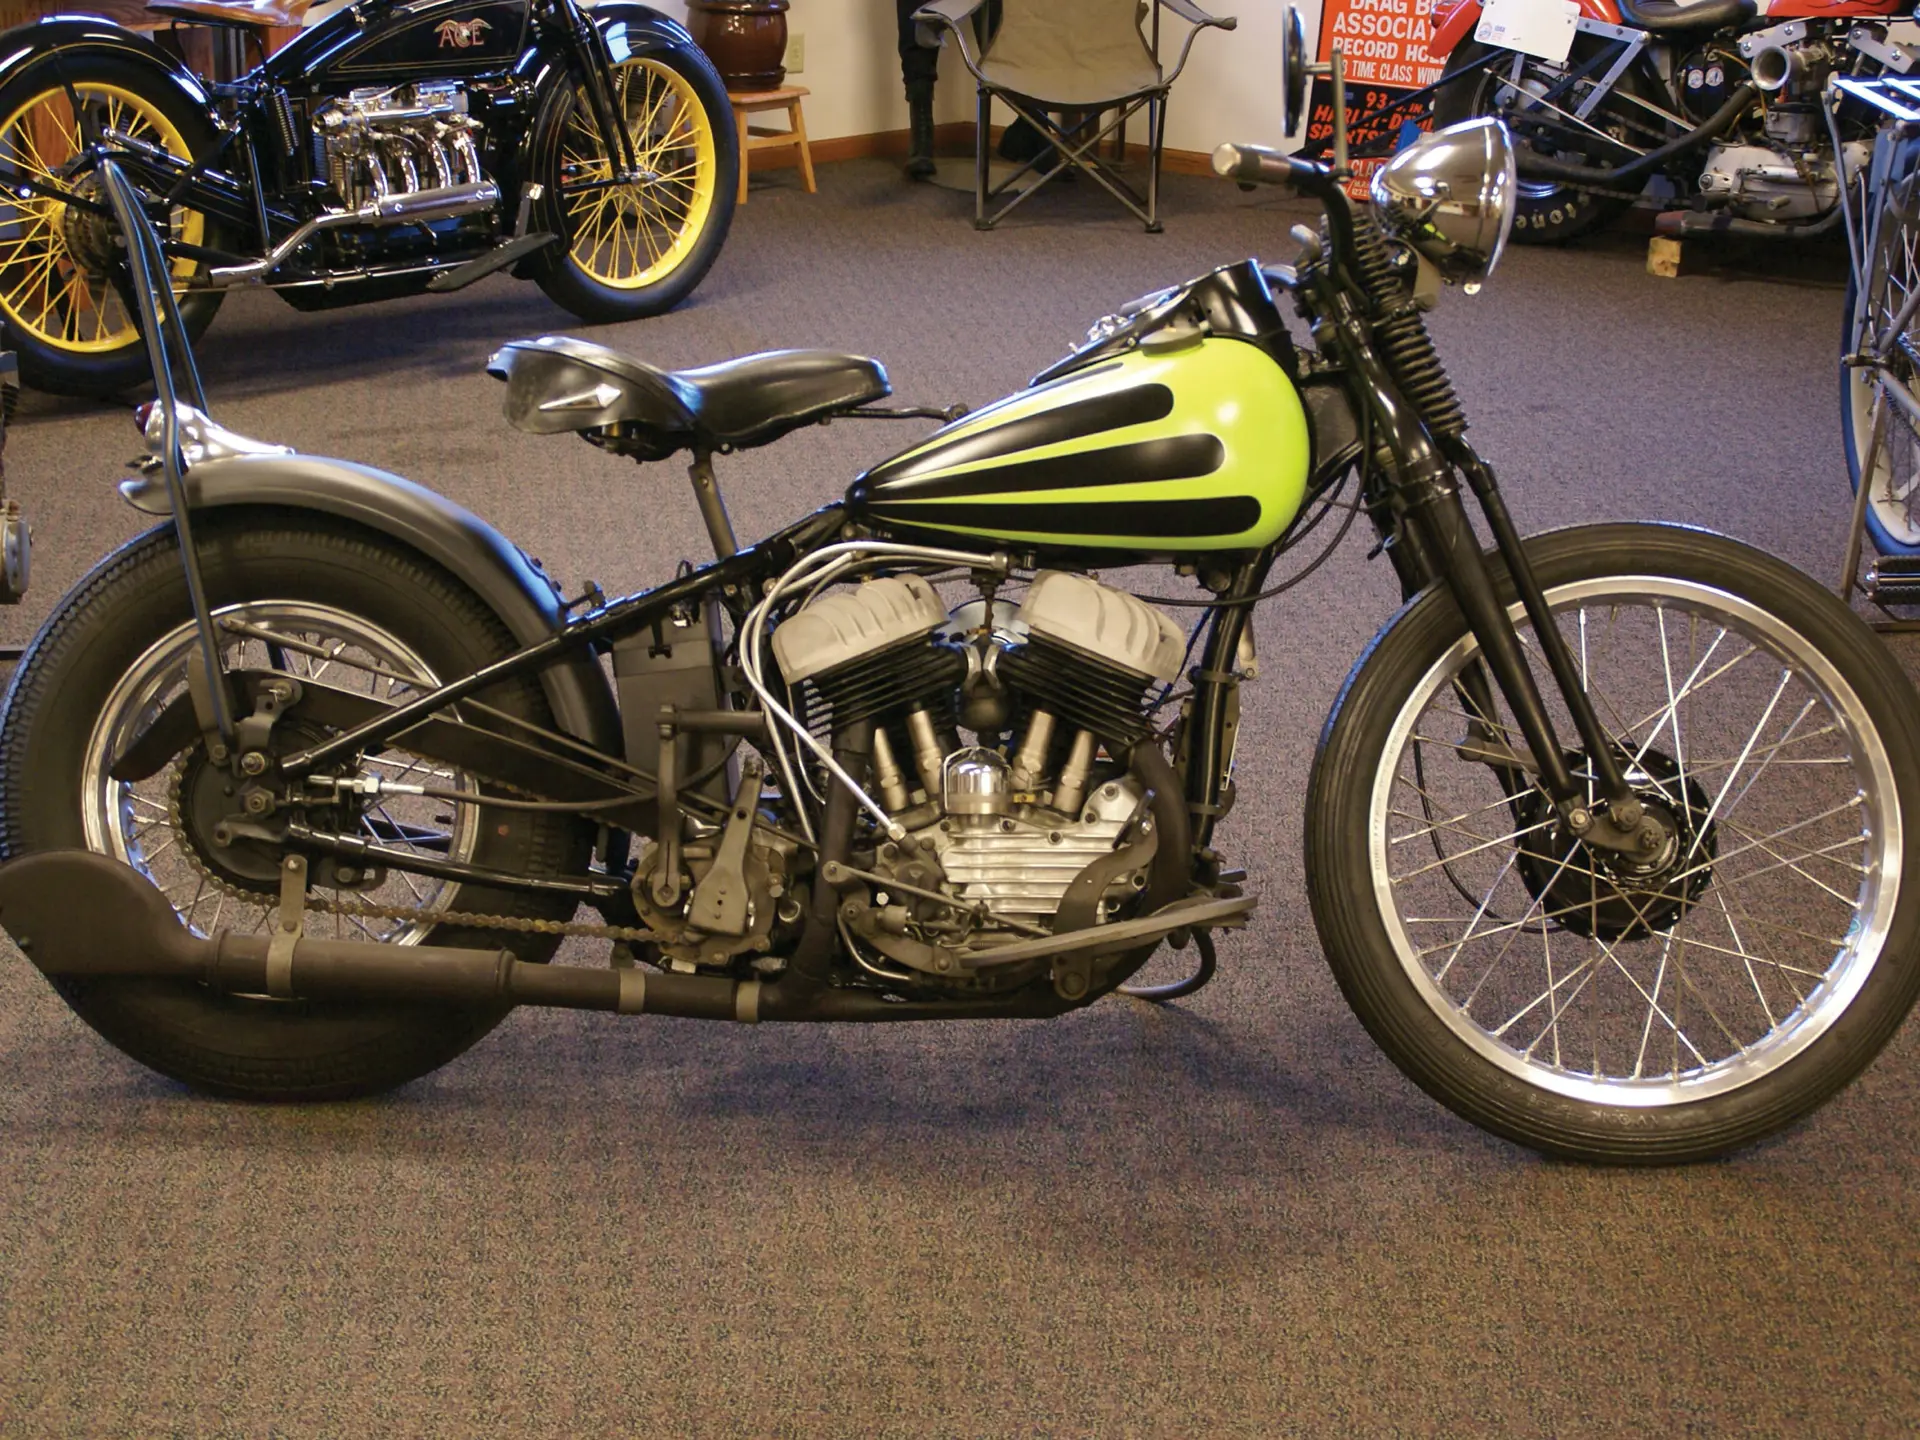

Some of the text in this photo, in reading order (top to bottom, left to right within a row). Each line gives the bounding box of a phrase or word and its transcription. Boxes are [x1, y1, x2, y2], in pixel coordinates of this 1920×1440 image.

[438, 23, 485, 48] ACE
[1332, 36, 1398, 60] RECORD
[1352, 60, 1377, 79] TIME
[1380, 63, 1413, 83] CLASS
